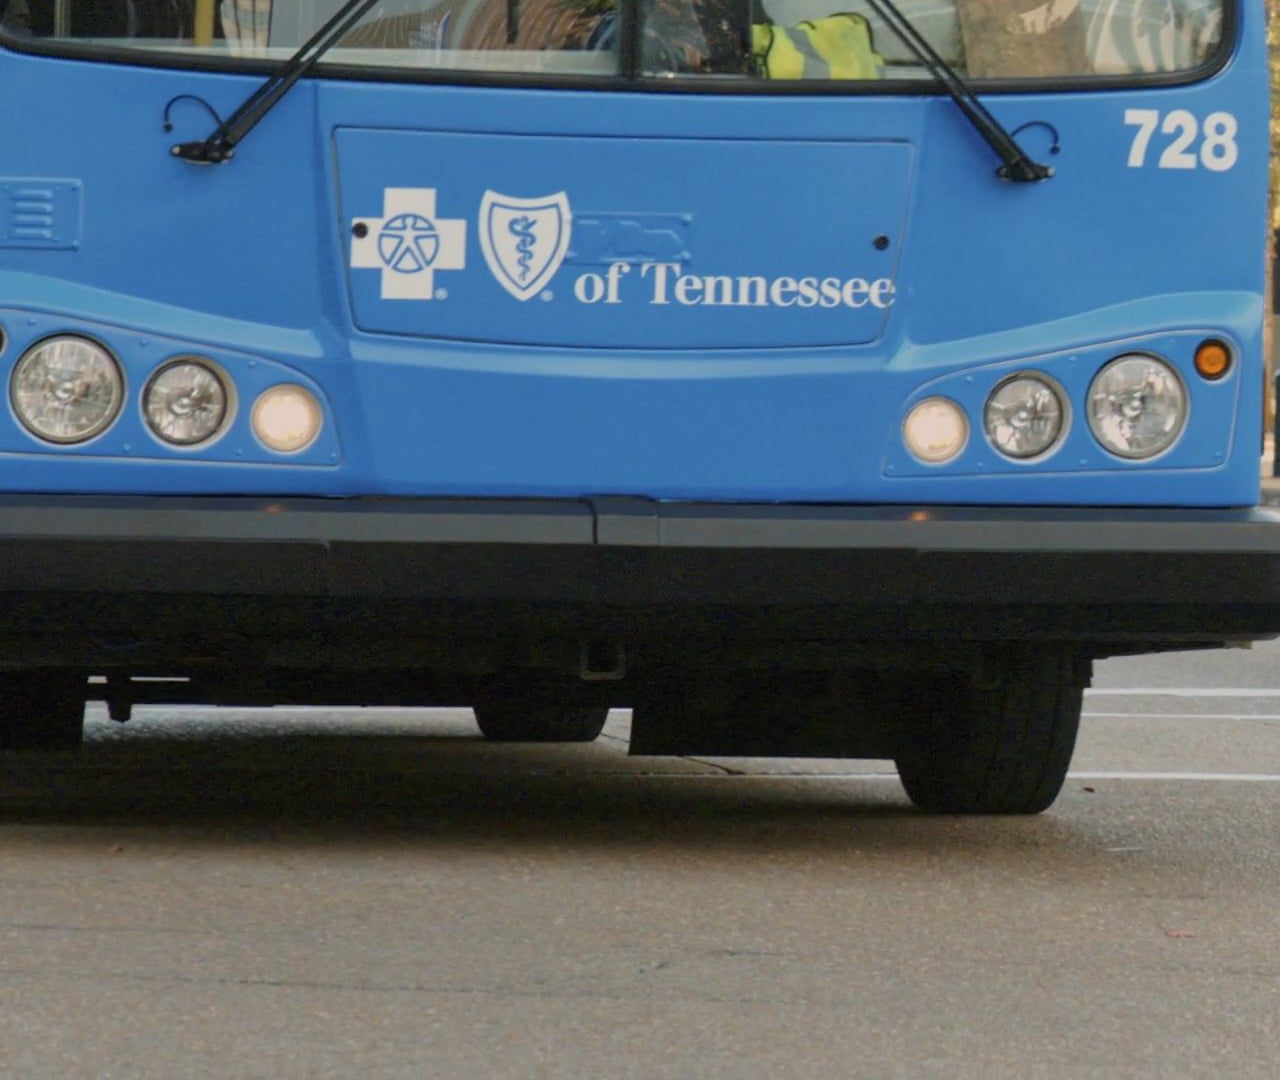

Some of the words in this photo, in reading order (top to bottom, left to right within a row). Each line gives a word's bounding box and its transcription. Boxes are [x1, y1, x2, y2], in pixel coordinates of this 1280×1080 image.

[1124, 108, 1239, 172] 728
[574, 261, 630, 304] of
[641, 262, 896, 308] Tennessee
